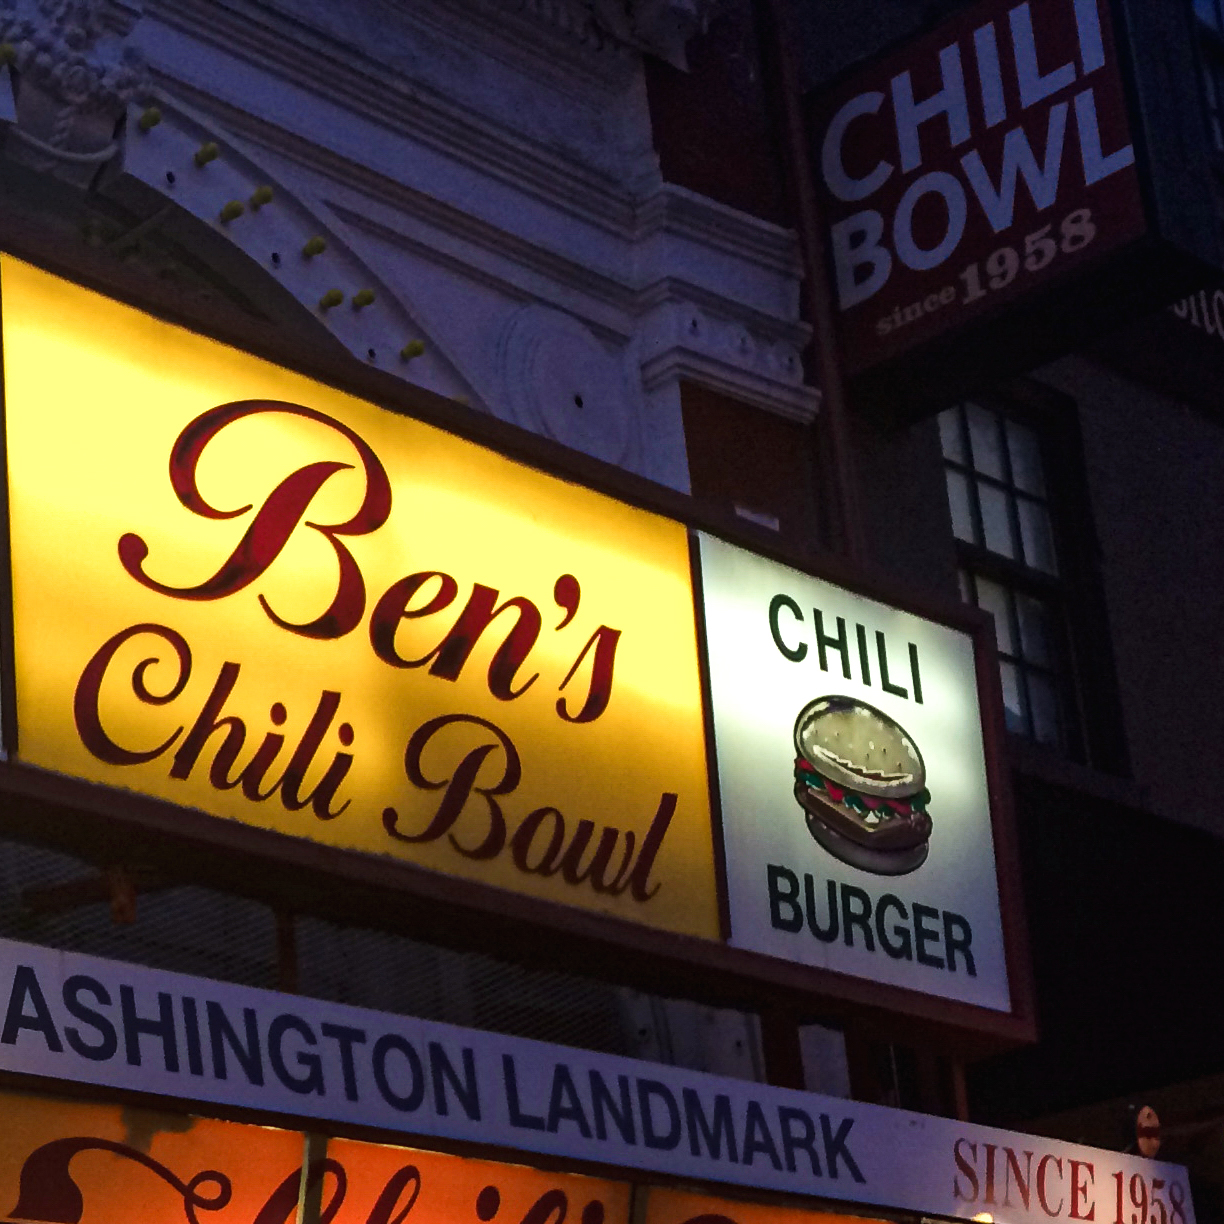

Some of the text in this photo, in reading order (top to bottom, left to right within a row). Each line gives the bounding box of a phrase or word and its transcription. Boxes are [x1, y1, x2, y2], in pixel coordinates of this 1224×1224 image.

[821, 0, 1106, 200] CHILI
[830, 87, 1136, 311] BOWL
[875, 207, 1097, 336] since 1958
[117, 398, 622, 724] Ben's
[769, 594, 924, 704] CHILI
[73, 623, 678, 901] Chili Bowl
[767, 864, 977, 977] BURGER
[501, 1052, 867, 1186] LANDMARK
[952, 1137, 1096, 1222] SINCE
